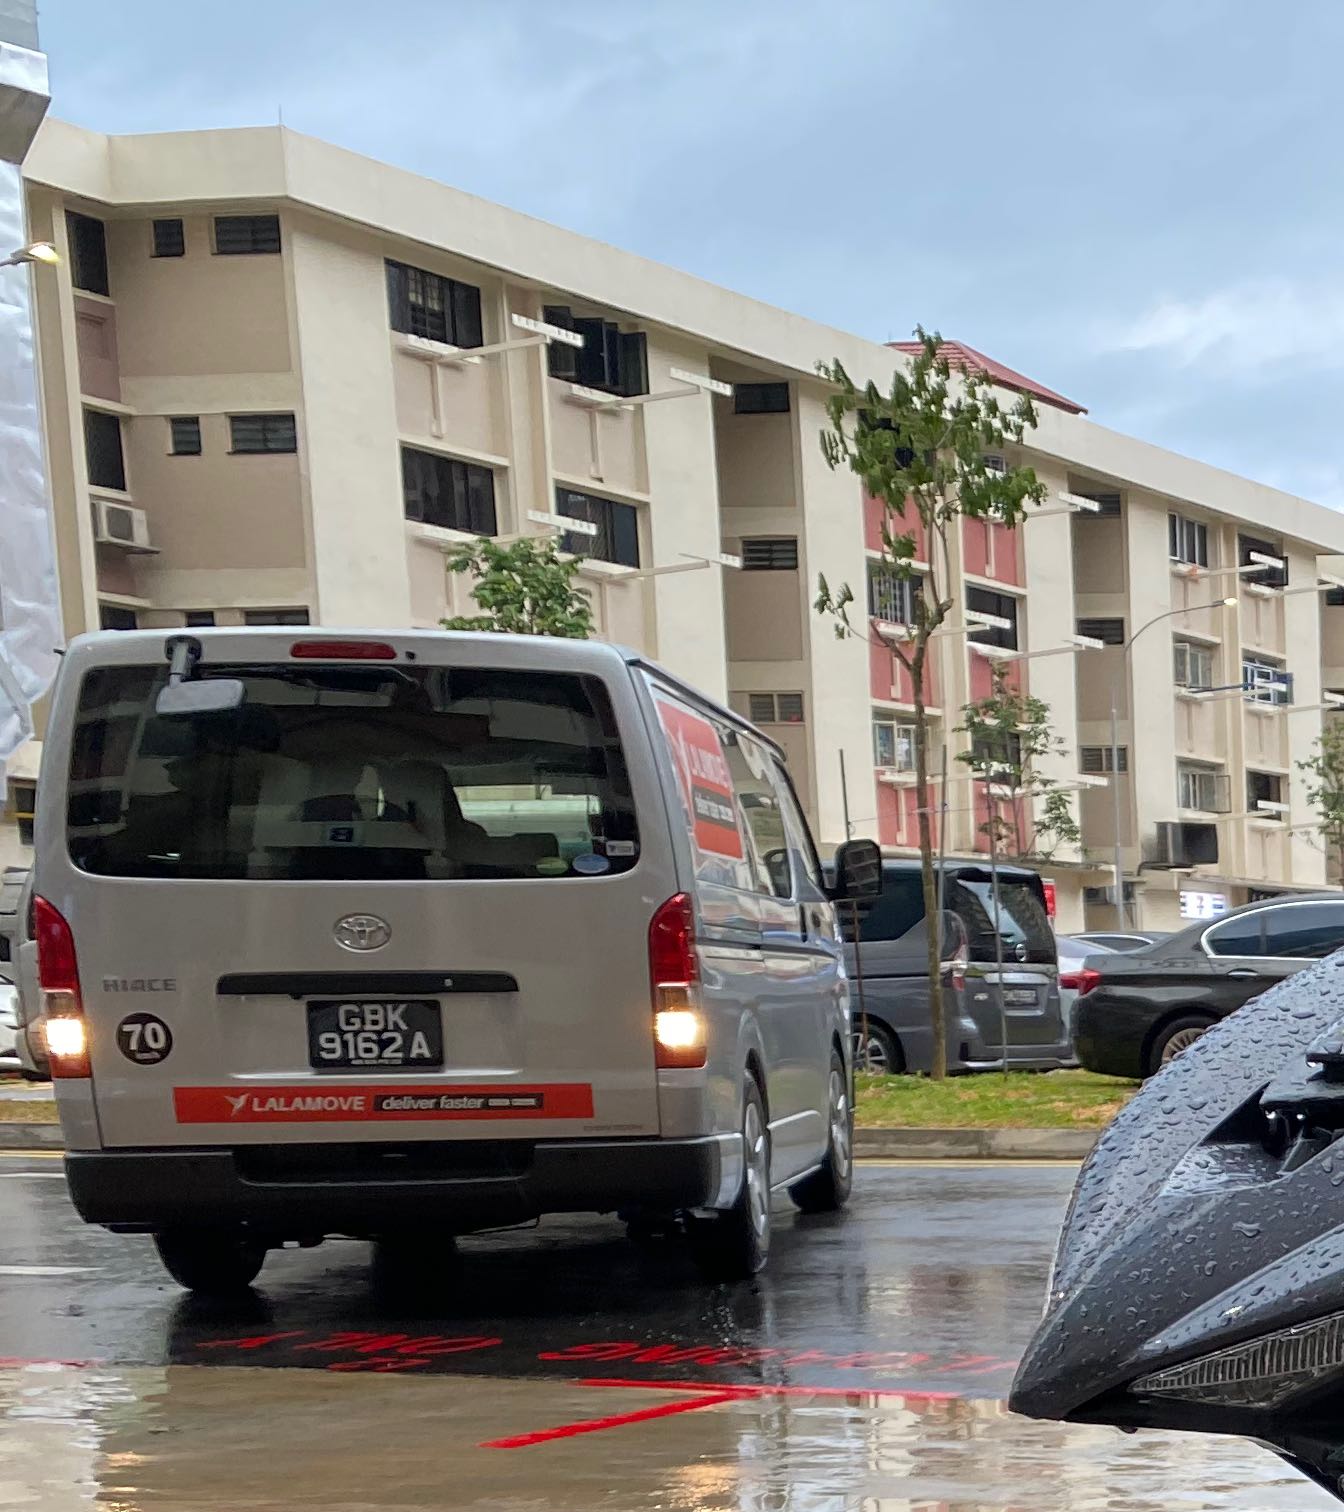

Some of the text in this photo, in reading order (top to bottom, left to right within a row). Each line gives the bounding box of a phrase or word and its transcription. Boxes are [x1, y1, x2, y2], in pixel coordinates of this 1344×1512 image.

[102, 978, 177, 993] HIACE
[338, 1003, 408, 1031] GBK
[122, 1022, 167, 1051] 70
[252, 1096, 365, 1112] LALAMOVE
[382, 1095, 437, 1111] deliver
[439, 1094, 484, 1109] faster
